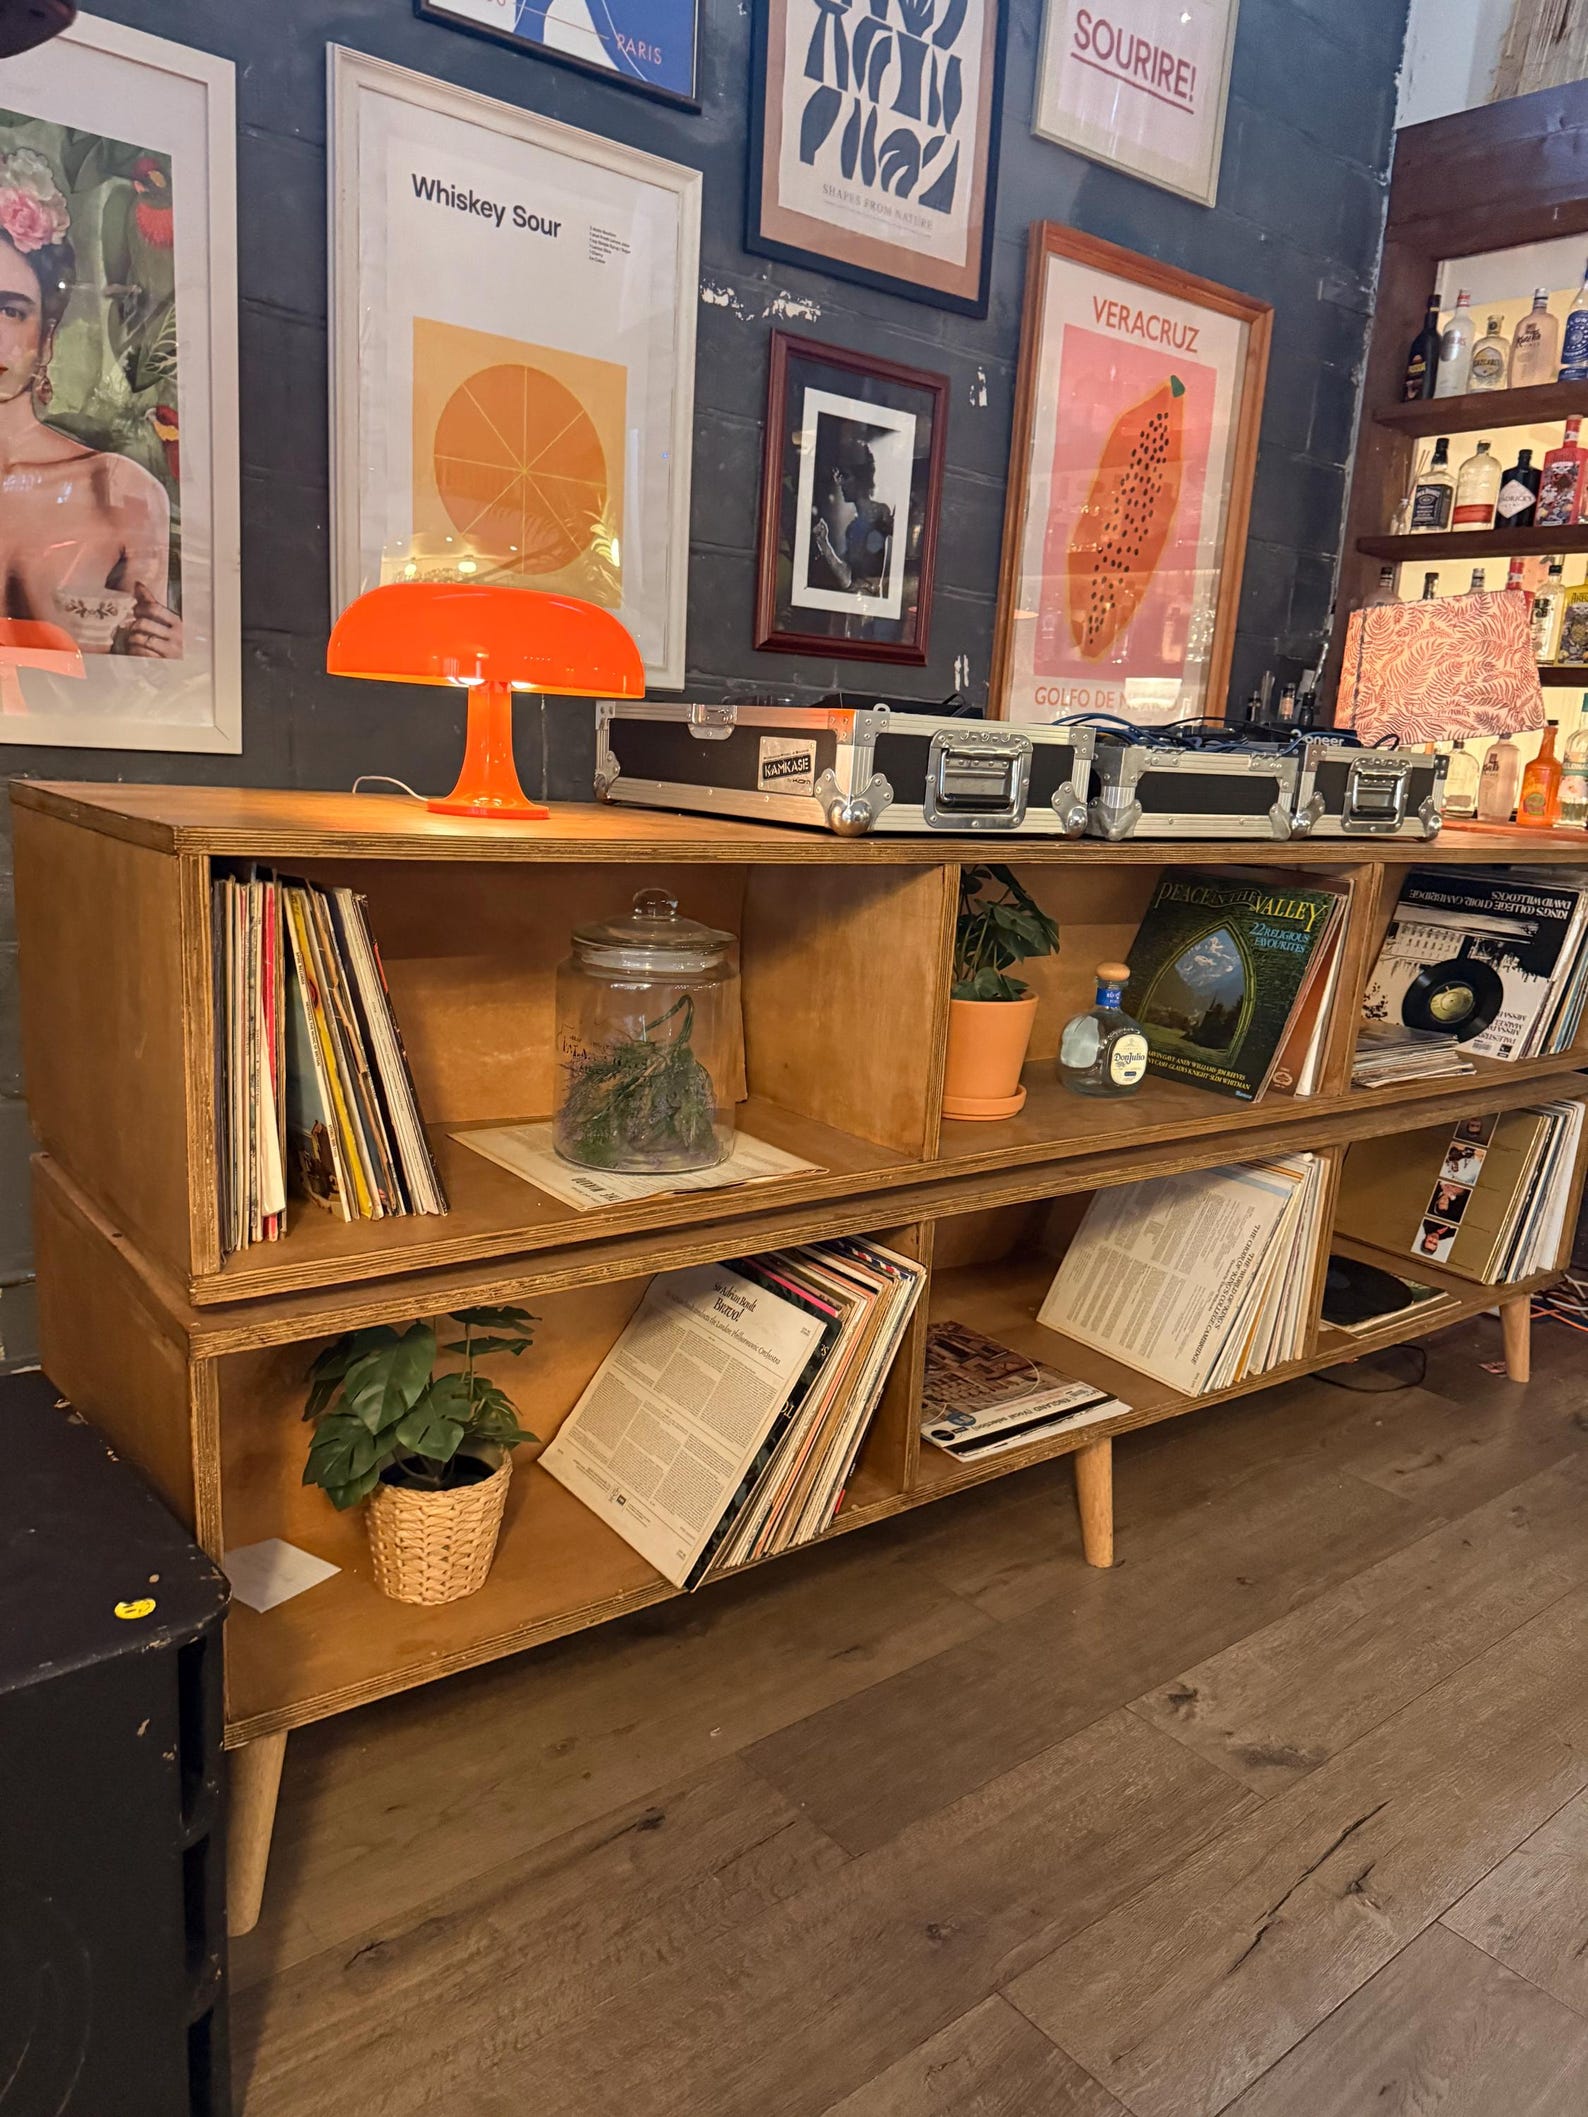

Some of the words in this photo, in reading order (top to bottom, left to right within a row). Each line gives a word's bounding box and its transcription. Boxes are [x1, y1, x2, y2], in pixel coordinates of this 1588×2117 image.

[615, 33, 663, 65] PARIS
[1073, 9, 1197, 102] SOURIRE!
[411, 173, 506, 228] Whiskey
[512, 204, 562, 238] Sour
[822, 183, 863, 206] SHAPES
[863, 198, 893, 217] FROM
[895, 209, 934, 230] NATURE
[1092, 295, 1200, 354] VERACRUZ
[1034, 686, 1091, 707] GOLFO
[1094, 689, 1116, 708] DE
[764, 757, 809, 778] KAMKASE
[1153, 881, 1214, 909] PEACE
[1230, 889, 1258, 902] THE
[1251, 894, 1329, 933] VALLEY
[1408, 889, 1462, 906] CAMBRIDGE
[1491, 891, 1541, 906] WILLCOCKS
[1493, 900, 1536, 915] COLLEGE
[1541, 897, 1572, 910] DAVID
[1249, 922, 1266, 936] 22
[1265, 929, 1311, 944] RELIGIOUS
[1254, 937, 1306, 953] FAVOURITES
[1222, 1077, 1252, 1091] WHITMAN
[1249, 1223, 1261, 1241] THE
[1240, 1239, 1254, 1263] CHOIR
[1244, 1252, 1256, 1270] THE
[1232, 1267, 1245, 1296] WORLD
[713, 1297, 745, 1322] Bravo!
[1212, 1290, 1228, 1324] COLLEGE
[1190, 1321, 1213, 1366] CAMBRIDGE
